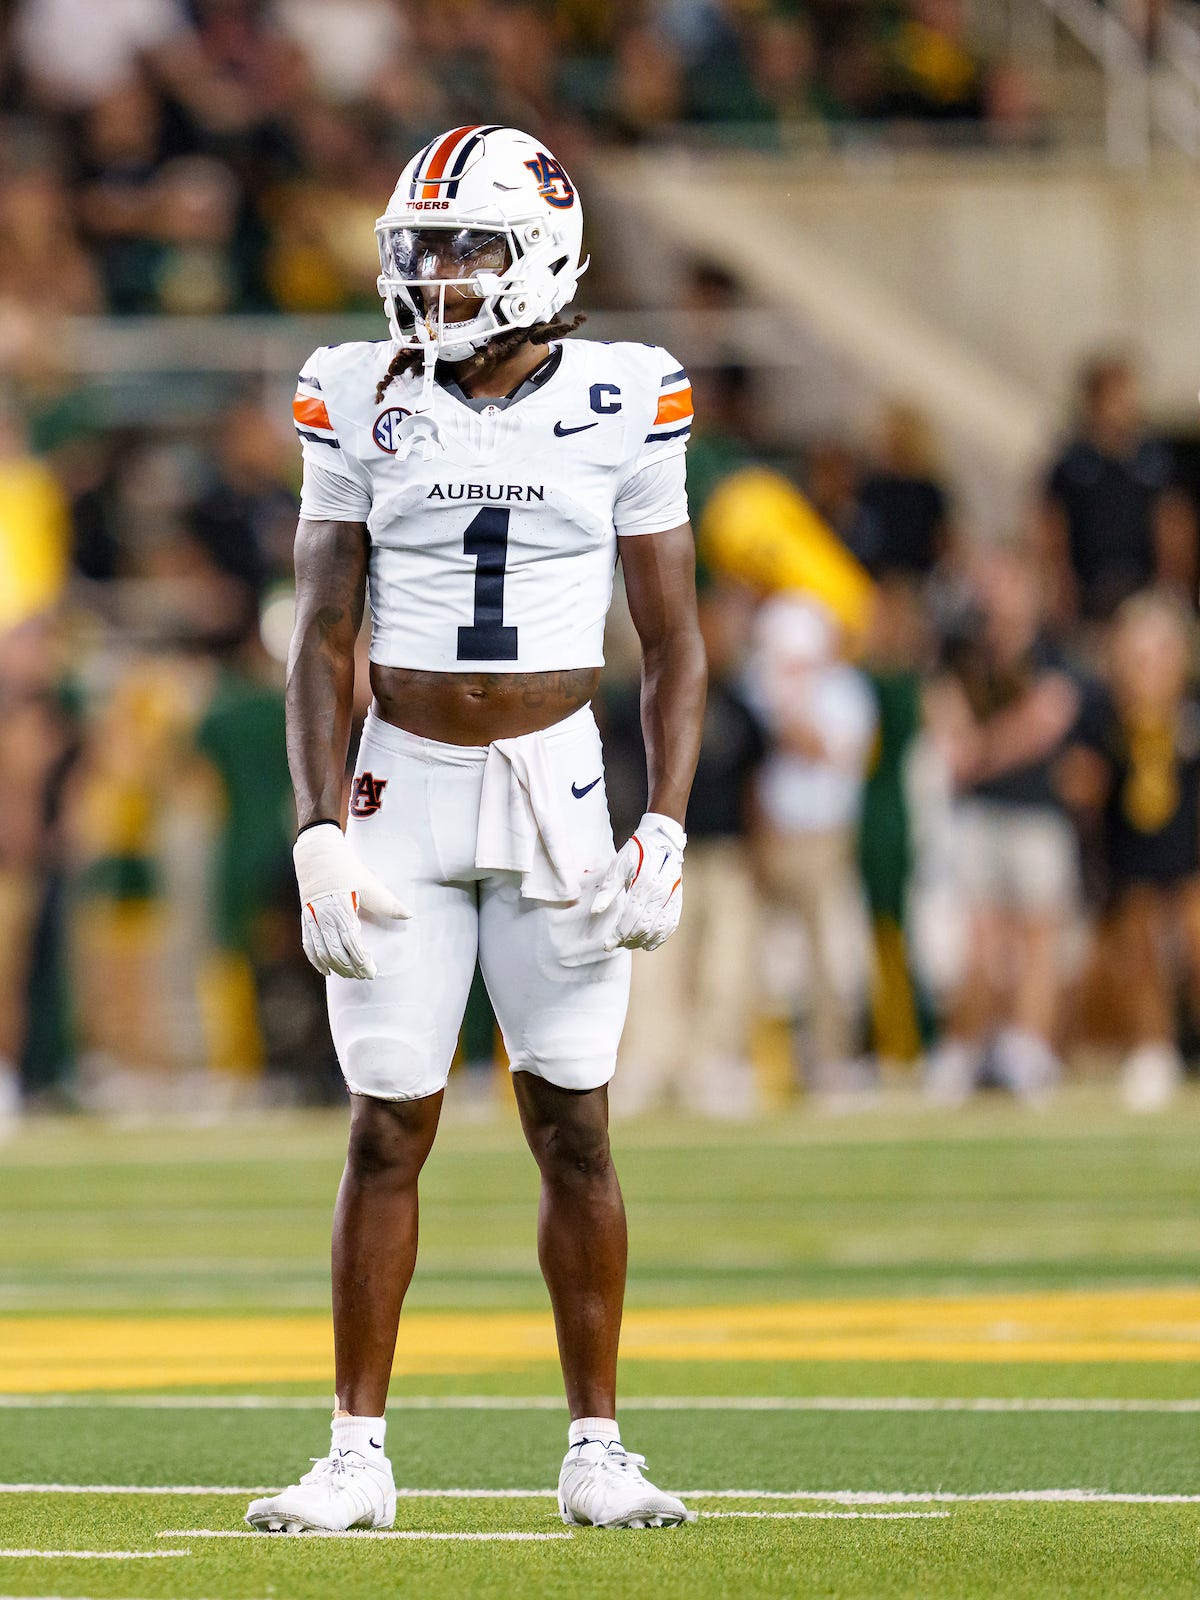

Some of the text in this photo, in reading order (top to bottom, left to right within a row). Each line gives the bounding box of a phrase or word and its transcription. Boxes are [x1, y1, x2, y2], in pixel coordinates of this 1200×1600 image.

[405, 201, 450, 210] TIGERS
[589, 383, 622, 414] C
[427, 484, 545, 501] AUBURN
[456, 507, 518, 661] 1
